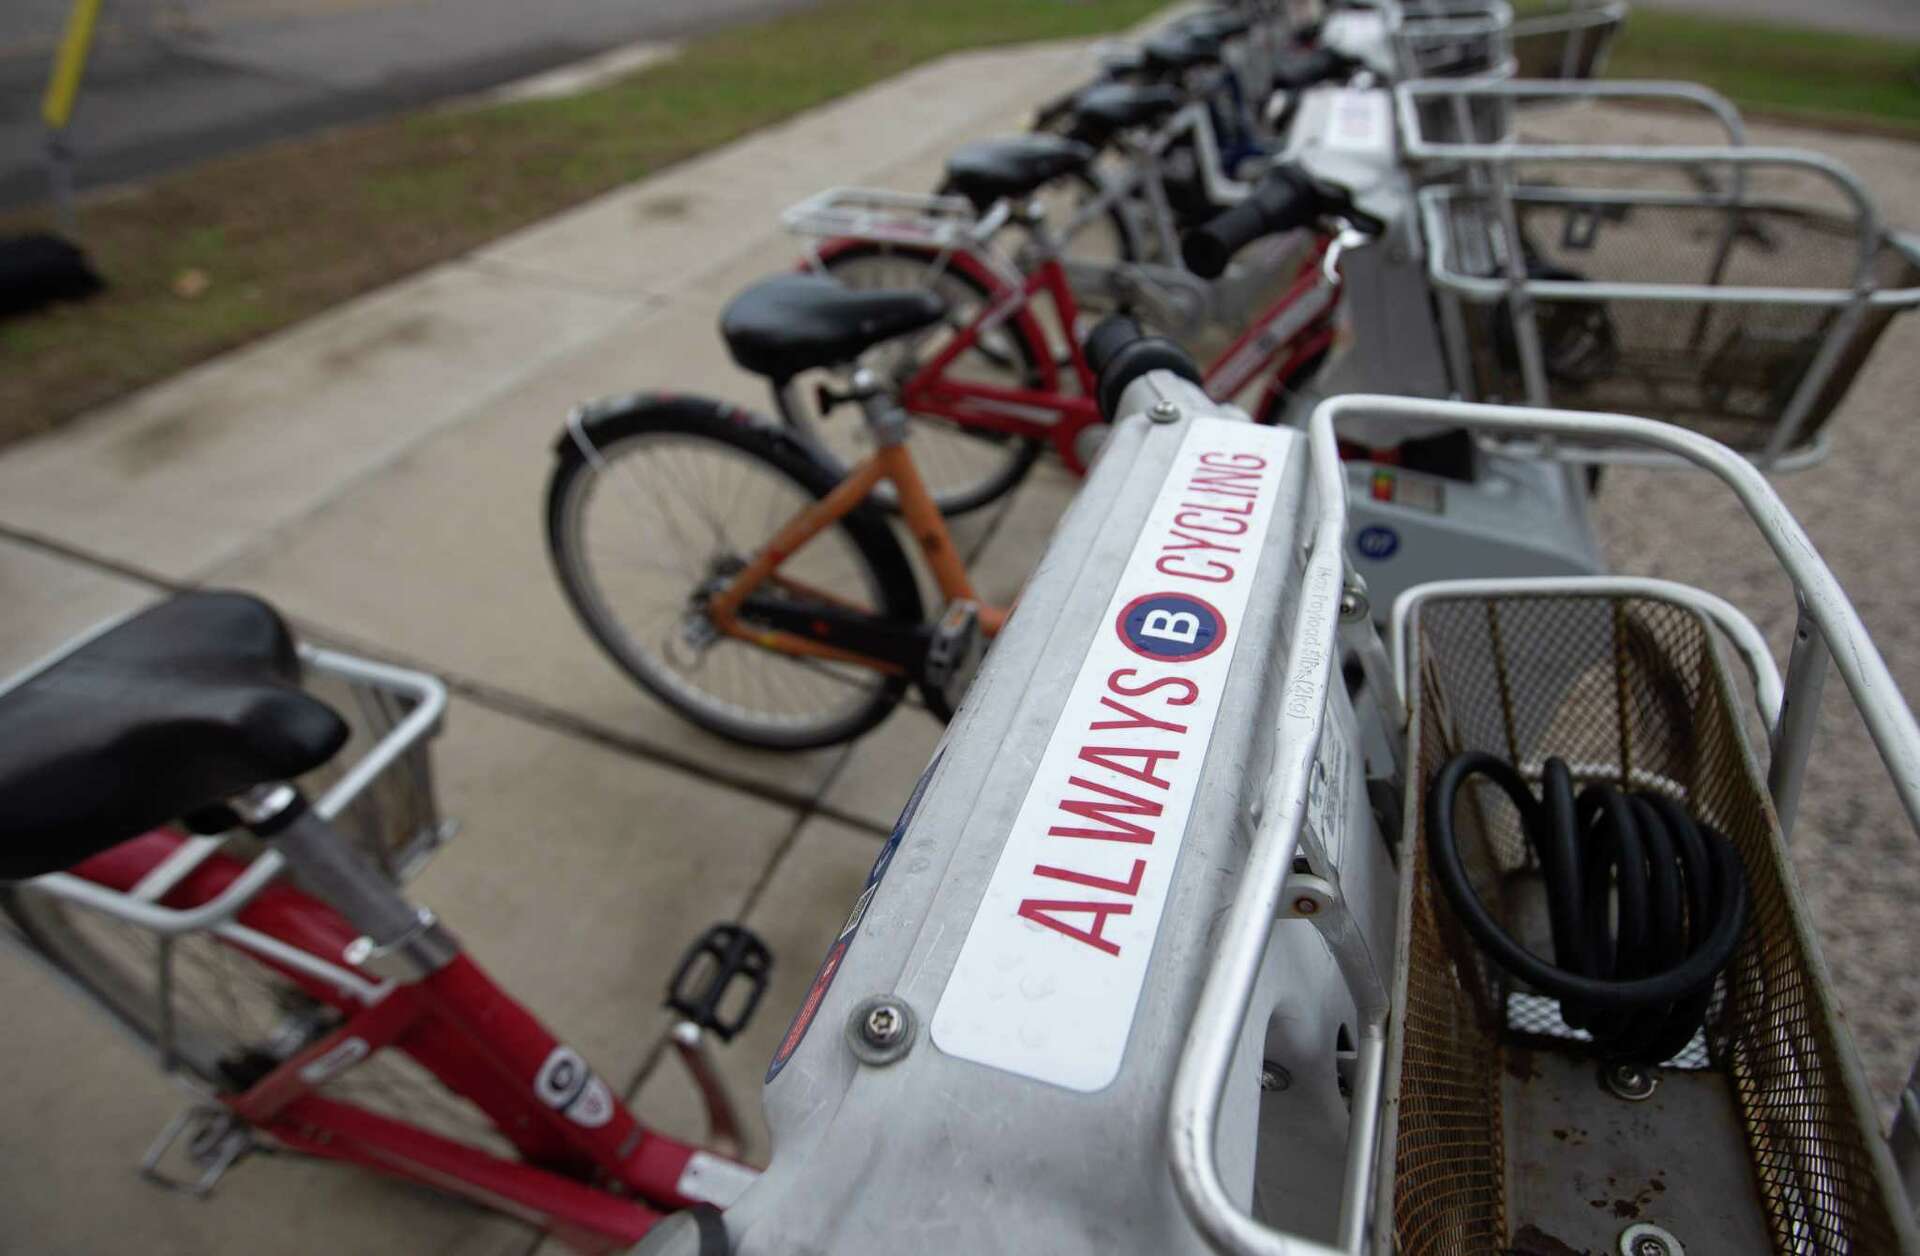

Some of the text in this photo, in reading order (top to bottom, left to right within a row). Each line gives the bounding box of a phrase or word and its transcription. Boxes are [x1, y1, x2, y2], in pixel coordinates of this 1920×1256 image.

[1155, 451, 1267, 583] CYCLING
[1140, 608, 1201, 645] B
[1017, 667, 1200, 957] ALWAYS
